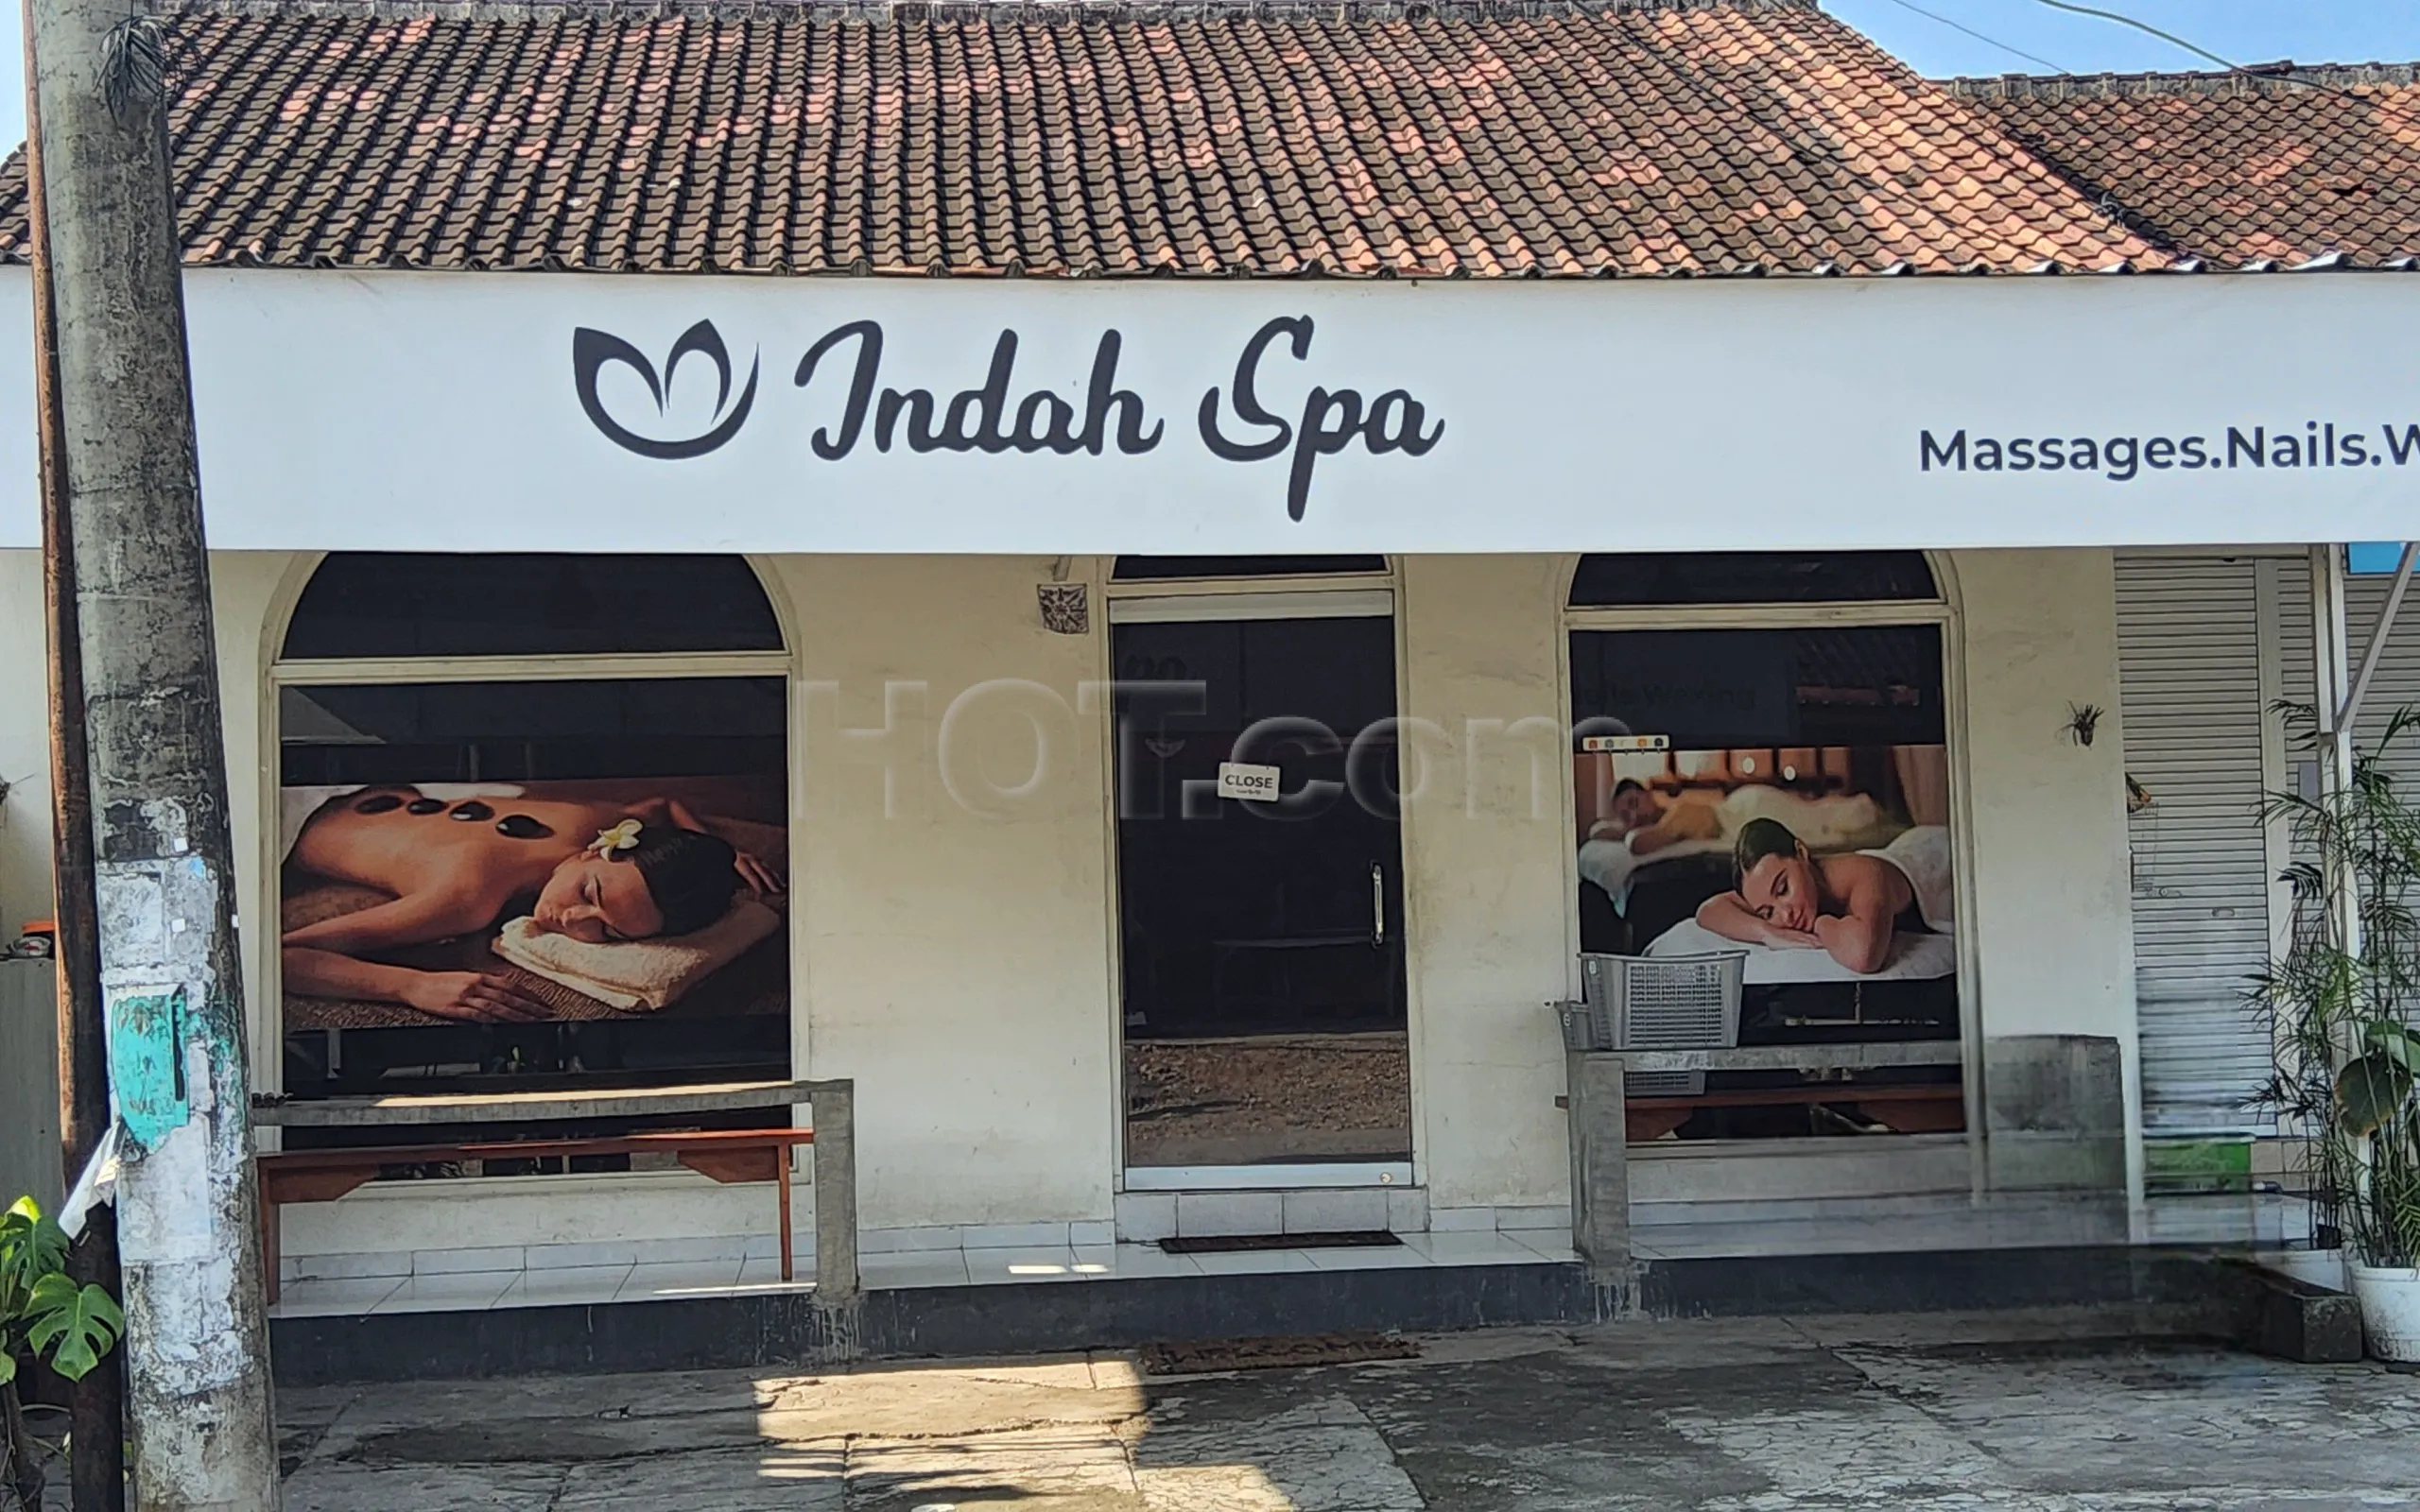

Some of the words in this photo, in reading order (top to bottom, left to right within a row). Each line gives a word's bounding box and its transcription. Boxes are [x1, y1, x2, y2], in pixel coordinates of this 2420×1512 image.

[794, 319, 1165, 461] Indah
[1198, 315, 1445, 523] Spa
[1225, 774, 1273, 789] CLOSE
